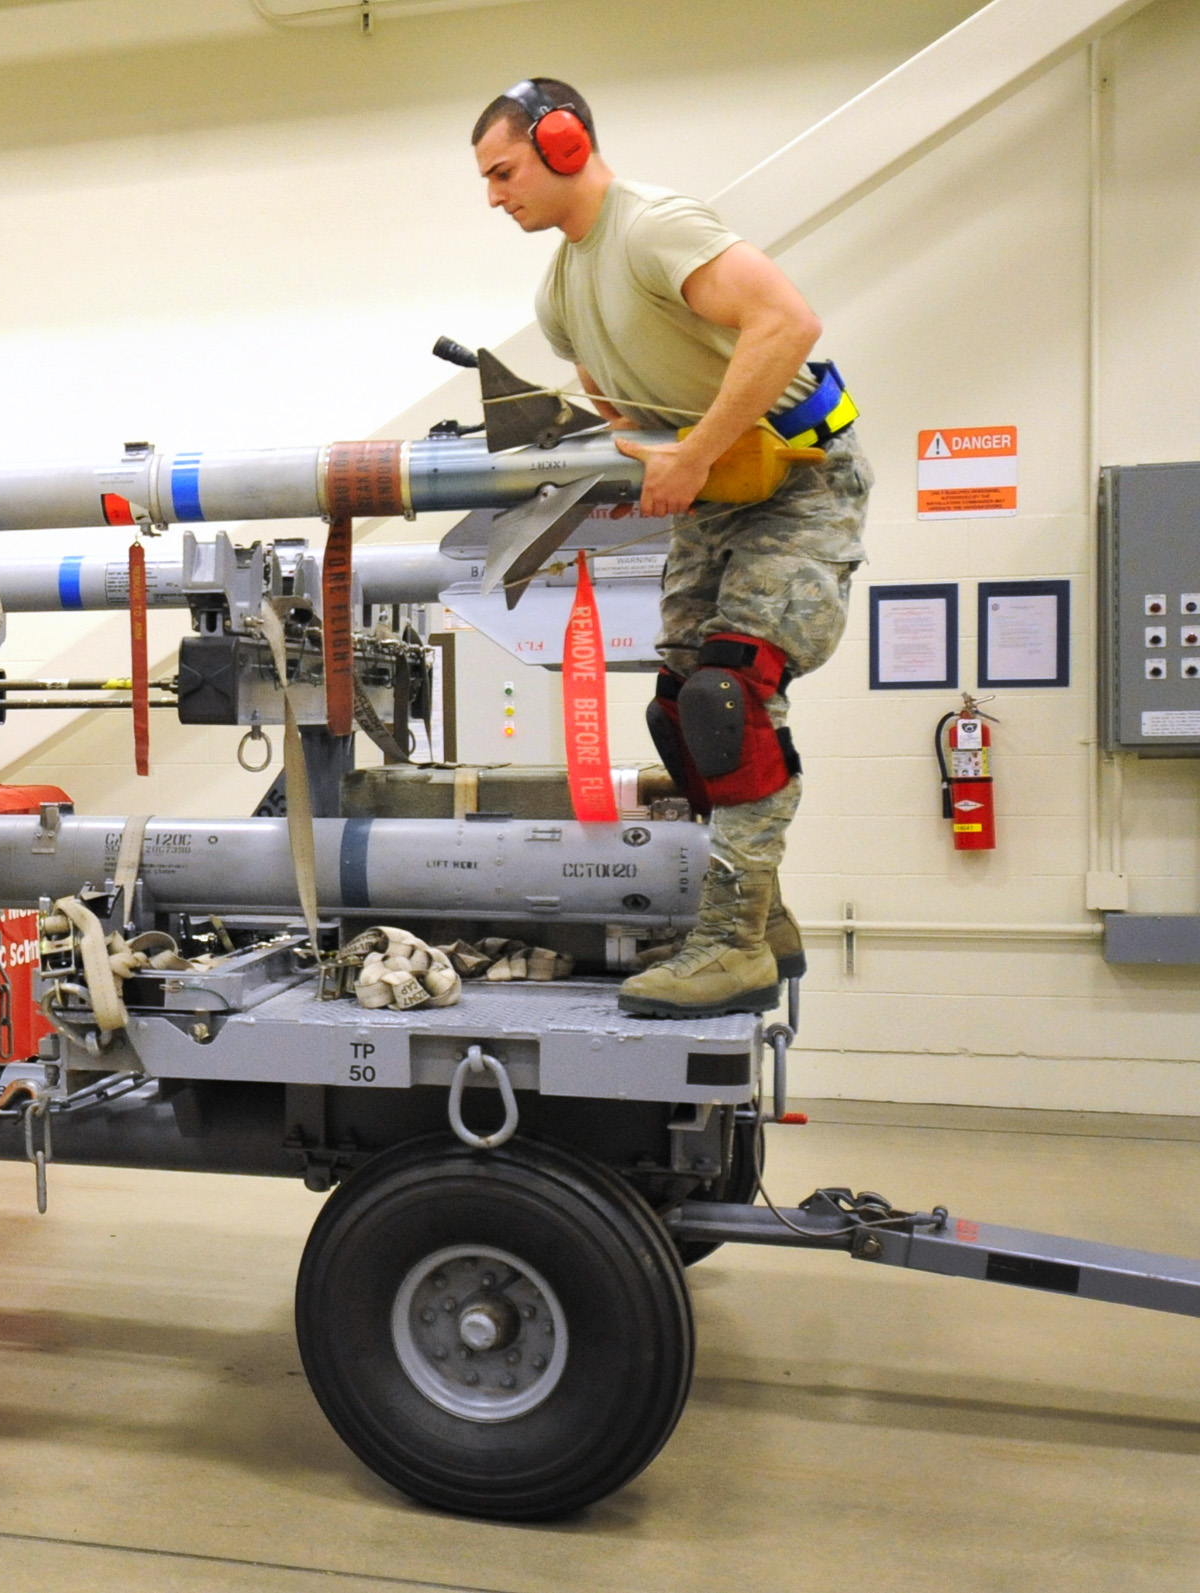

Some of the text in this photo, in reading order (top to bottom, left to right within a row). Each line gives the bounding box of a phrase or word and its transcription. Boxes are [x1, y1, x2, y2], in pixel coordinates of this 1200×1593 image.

[952, 434, 1011, 450] DANGER
[133, 605, 142, 616] TO
[331, 604, 351, 676] FLIGHT
[571, 606, 597, 681] REMOVE
[573, 698, 601, 765] BEFORE
[453, 861, 478, 869] HERE
[679, 847, 689, 893] NO LIFT
[401, 982, 418, 995] CAP
[350, 1043, 375, 1059] TP
[349, 1065, 376, 1083] 50
